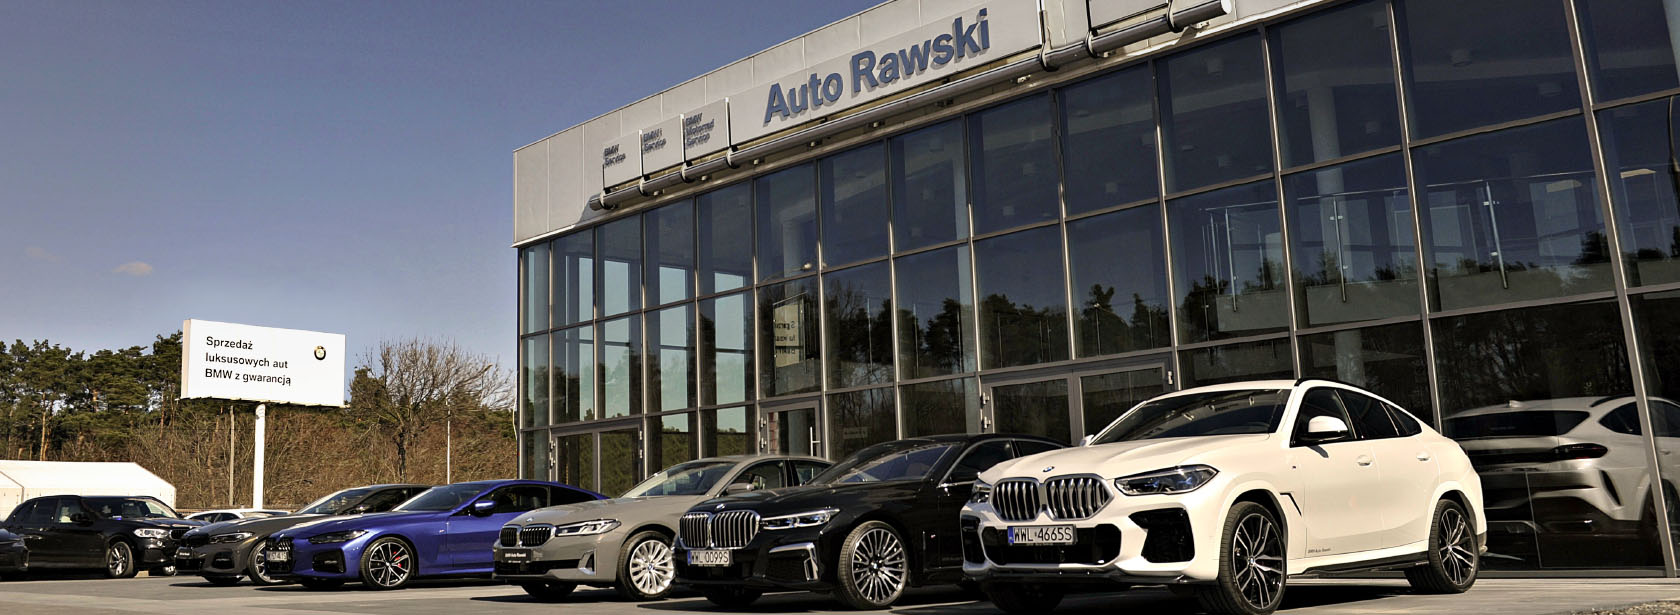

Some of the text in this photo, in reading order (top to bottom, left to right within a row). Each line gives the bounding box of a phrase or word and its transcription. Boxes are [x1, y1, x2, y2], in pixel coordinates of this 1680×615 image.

[765, 8, 990, 124] Auto Rawski
[686, 112, 703, 126] BMW
[686, 118, 715, 136] Motorrad
[643, 129, 659, 142] BMW
[686, 133, 711, 147] Service
[604, 143, 620, 157] BMW
[644, 138, 667, 153] Service
[604, 153, 626, 167] Service
[206, 336, 253, 350] Sprzedaż
[205, 352, 288, 369] luksusowych aut
[205, 368, 291, 386] BMW z gwarancją
[1014, 526, 1072, 542] WWL 4665S
[691, 551, 729, 563] WWL 0099S
